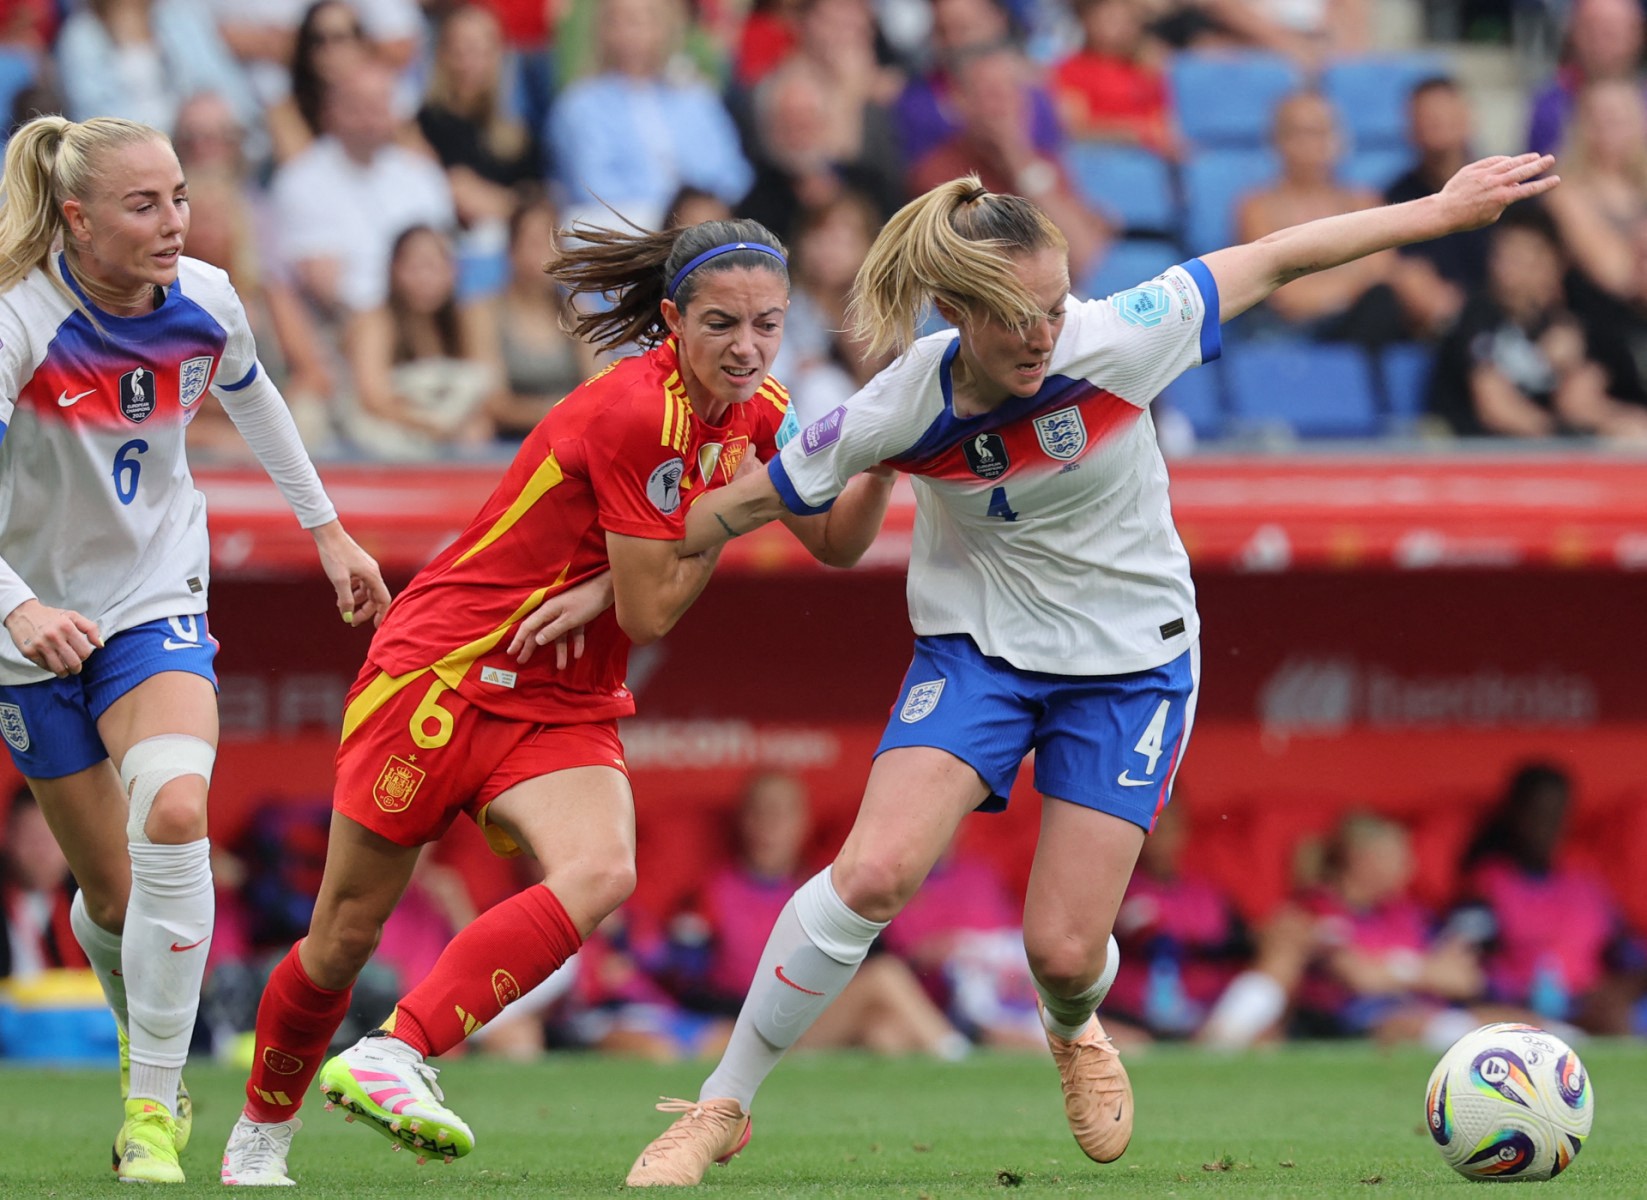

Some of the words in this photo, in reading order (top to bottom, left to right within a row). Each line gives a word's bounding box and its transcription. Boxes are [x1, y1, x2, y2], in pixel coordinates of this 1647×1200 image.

[111, 438, 149, 505] 6
[409, 678, 454, 749] 6
[1133, 698, 1171, 776] 4
